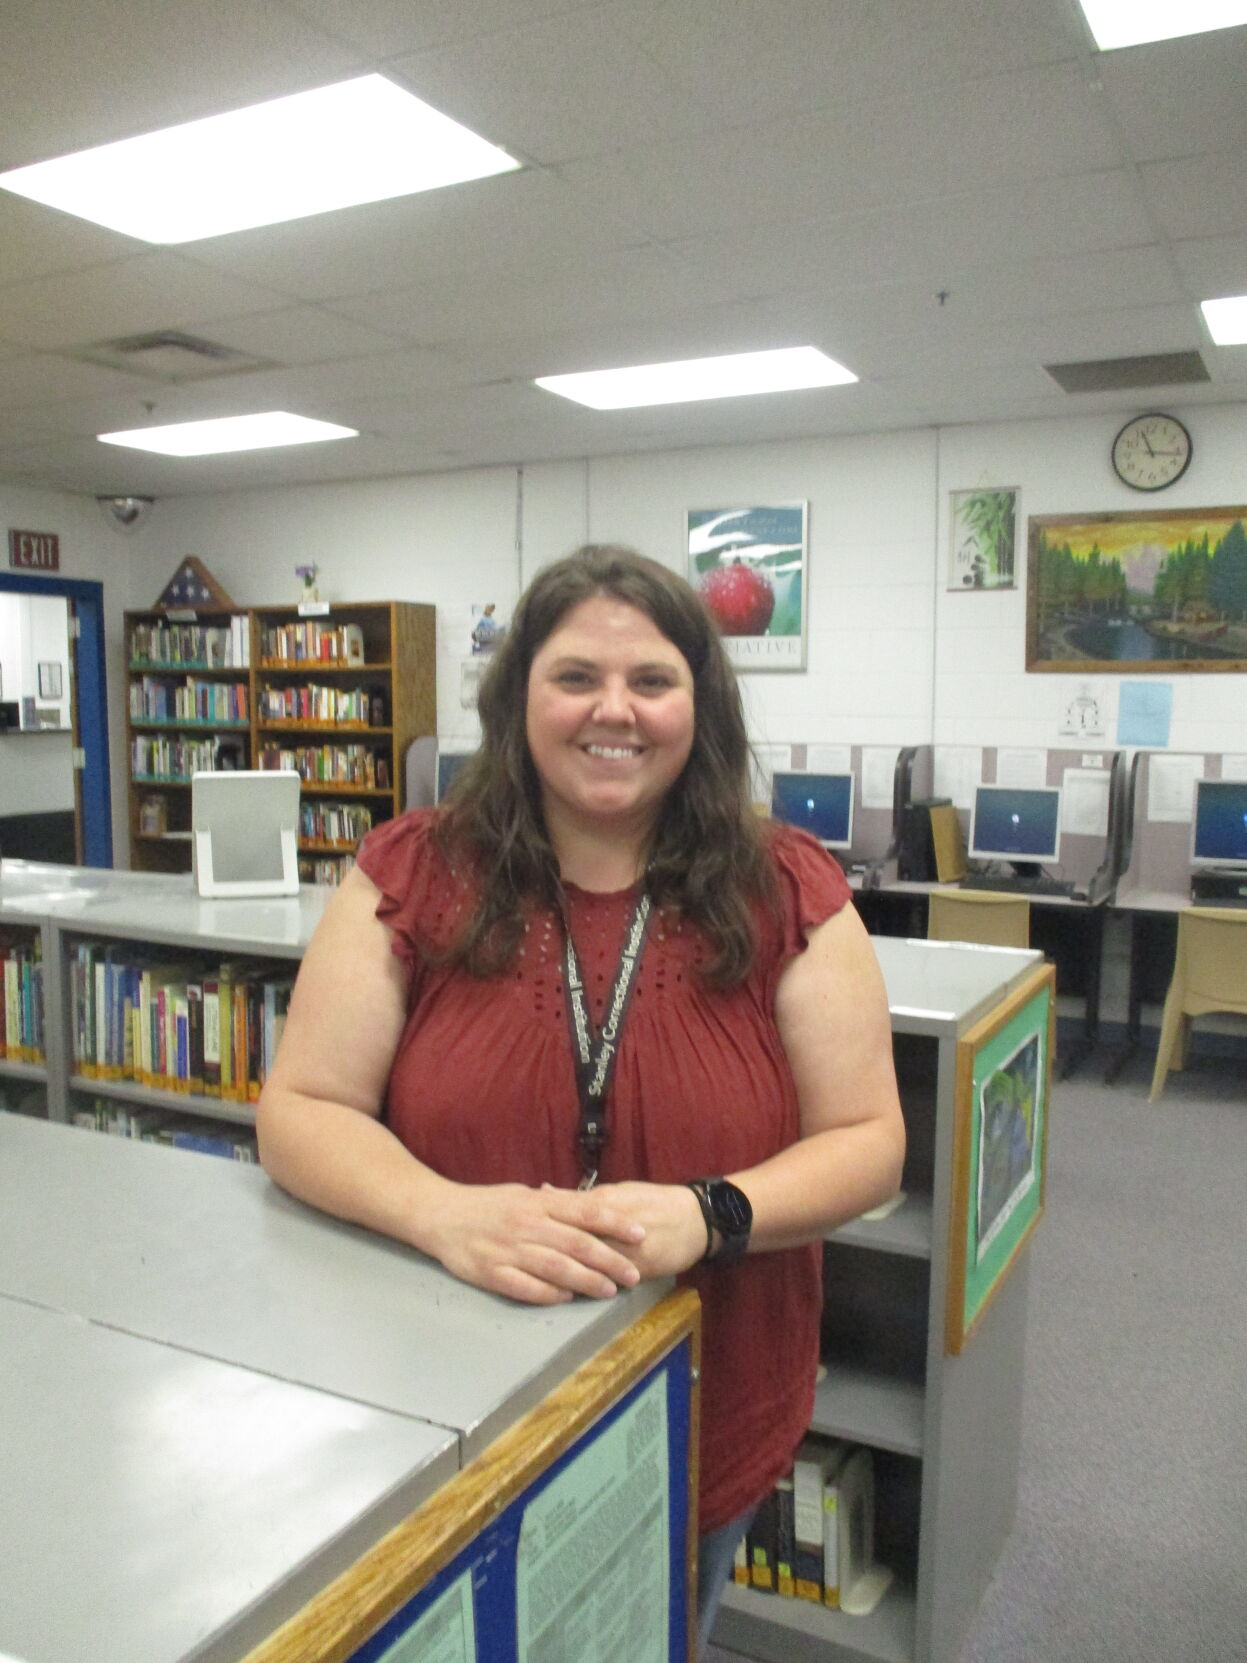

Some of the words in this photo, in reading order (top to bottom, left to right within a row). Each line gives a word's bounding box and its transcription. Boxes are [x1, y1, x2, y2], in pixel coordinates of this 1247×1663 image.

[19, 536, 53, 566] EXIT
[722, 640, 797, 653] TIATIVE
[588, 1041, 616, 1097] Stanley
[602, 957, 634, 1041] Correctional
